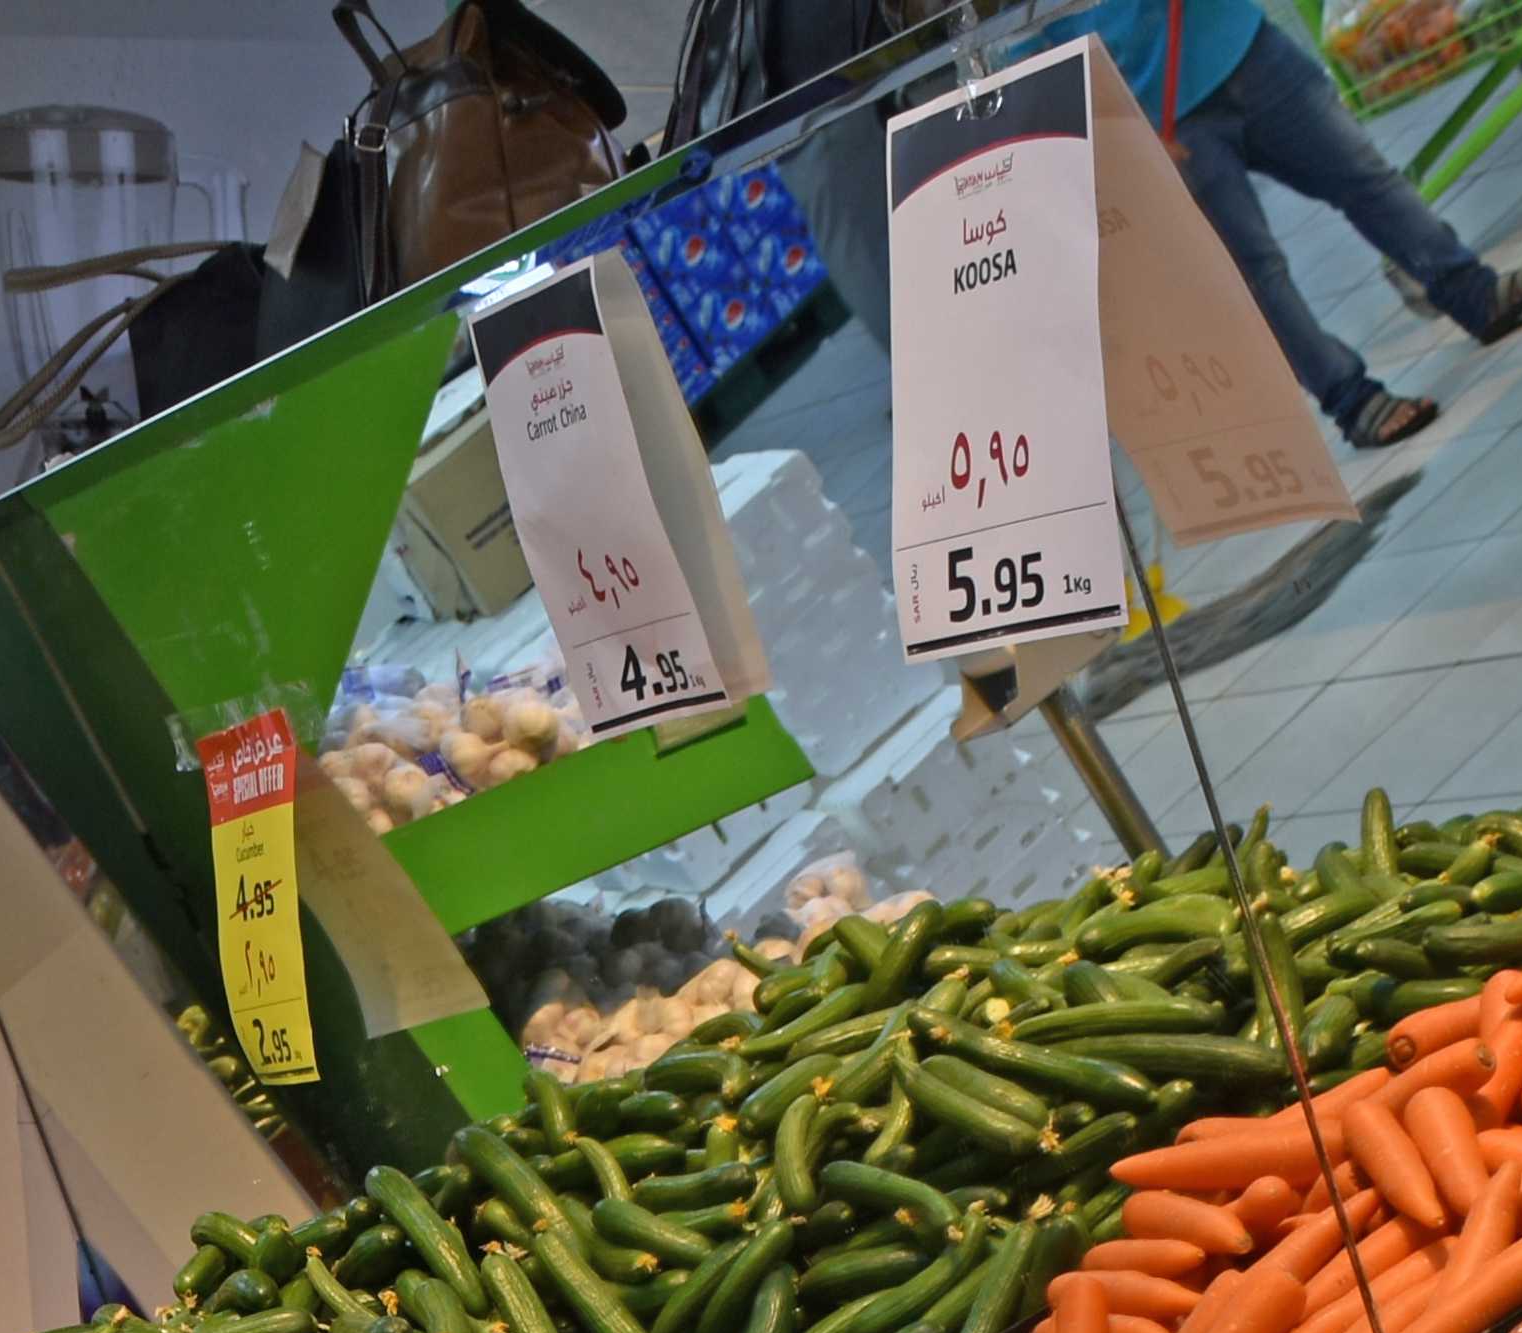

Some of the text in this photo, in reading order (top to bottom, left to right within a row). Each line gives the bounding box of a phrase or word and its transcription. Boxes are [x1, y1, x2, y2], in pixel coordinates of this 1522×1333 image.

[963, 209, 1007, 246] كوسا
[953, 249, 1017, 295] KOOSA
[527, 402, 587, 441] Carrot China
[948, 546, 1044, 623] 5.95
[1063, 574, 1092, 595] 1Kg
[911, 593, 921, 624] SAR
[620, 644, 689, 701] 4.95
[259, 763, 284, 796] OFFER
[236, 873, 275, 922] 4.95
[252, 1018, 292, 1066] 2.95
